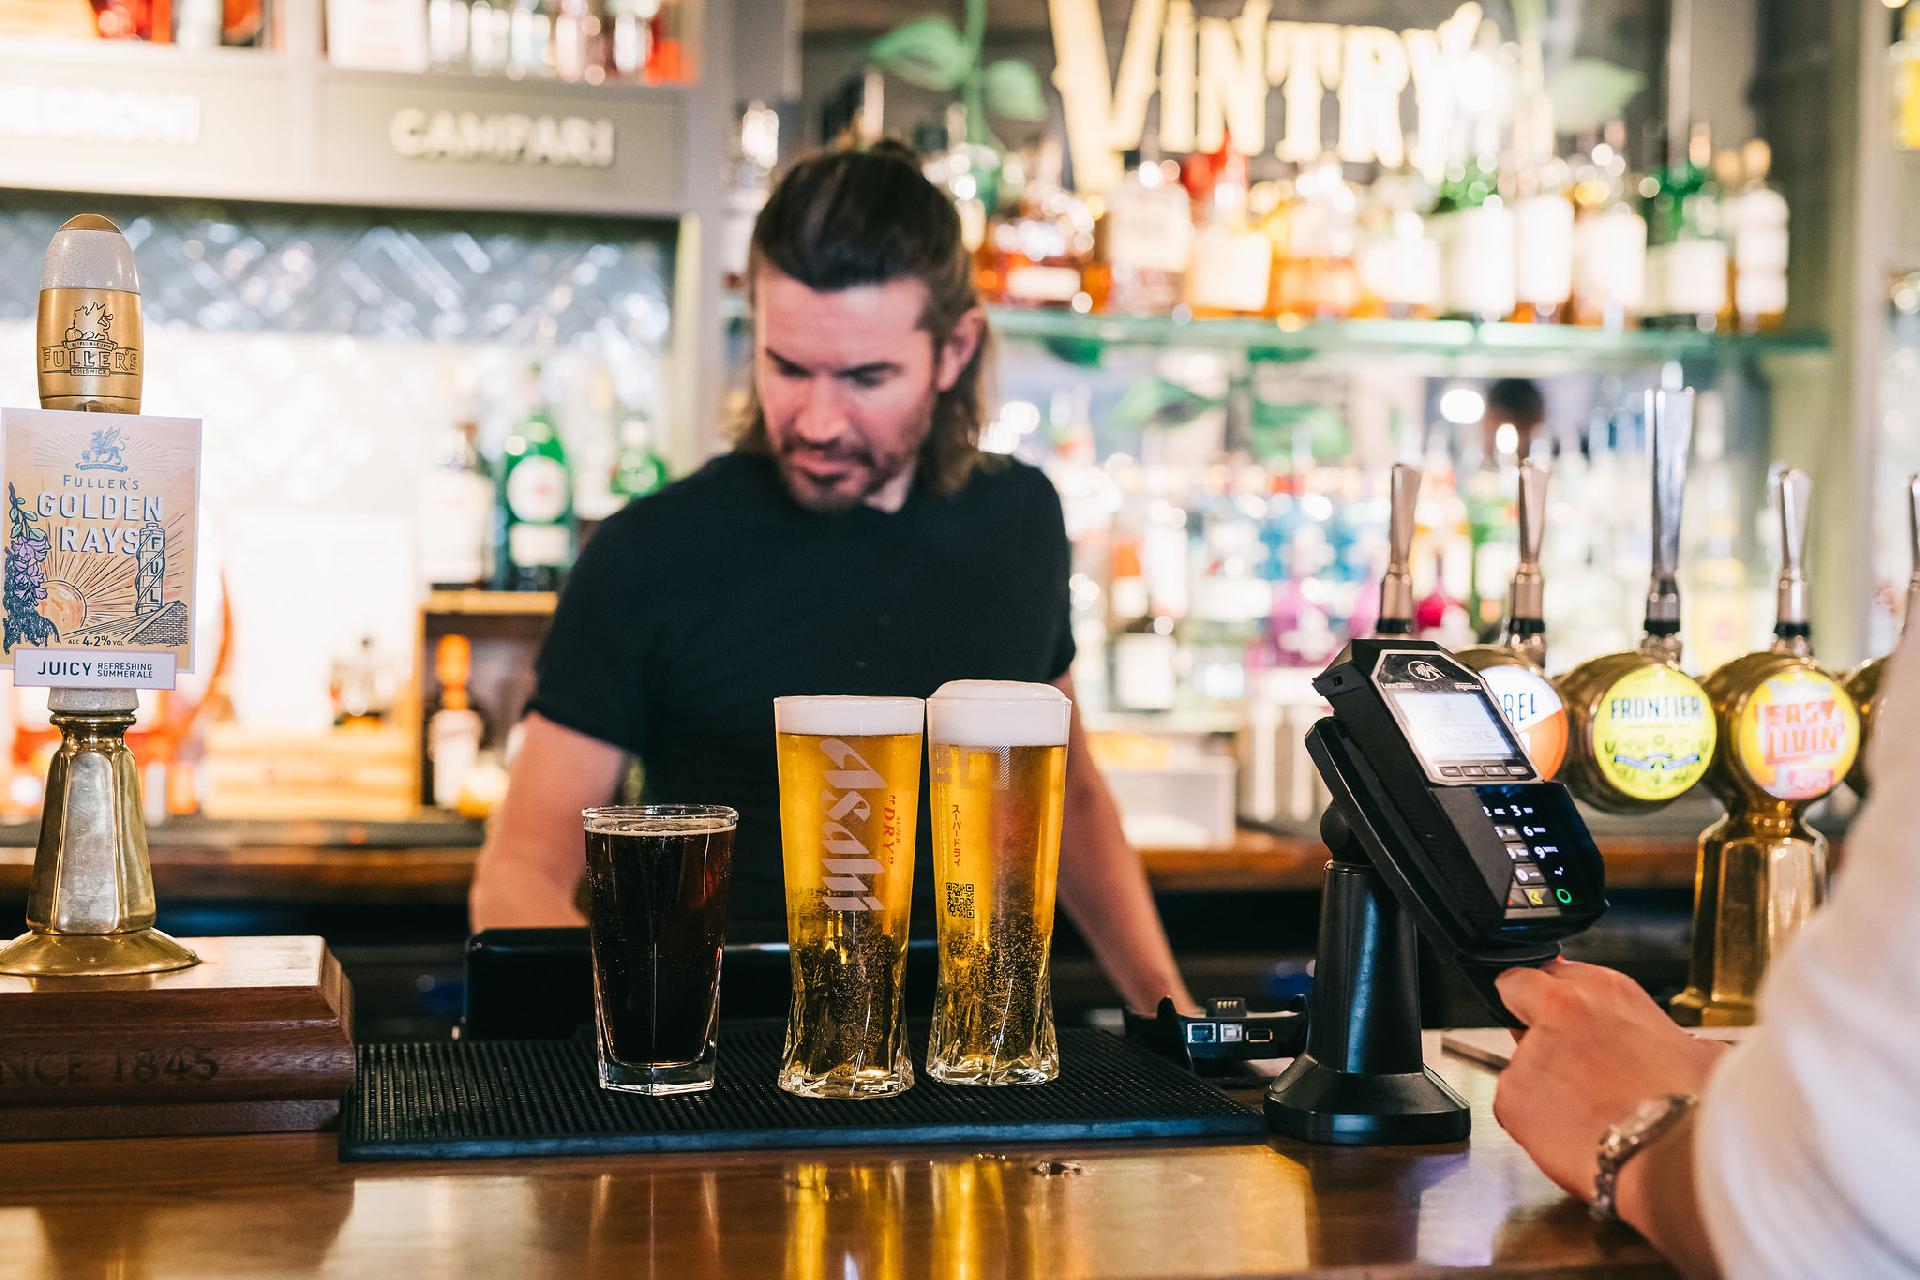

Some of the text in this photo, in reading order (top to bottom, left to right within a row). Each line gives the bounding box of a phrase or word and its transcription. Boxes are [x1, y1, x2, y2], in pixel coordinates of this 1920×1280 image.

[1049, 0, 1484, 195] VINTRY
[389, 108, 615, 166] CAMPARI
[43, 348, 137, 371] FULLER'S
[63, 474, 139, 490] FULLER'S
[37, 491, 163, 522] GOLDEN
[60, 526, 140, 554] RAYS
[82, 635, 111, 647] 4.2%
[38, 661, 92, 676] JUICY
[97, 662, 152, 670] REFRESHING
[1611, 694, 1701, 720] FRONTIER
[1765, 700, 1835, 725] EASY
[820, 738, 888, 911] Asahi
[113, 1047, 220, 1082] 1845
